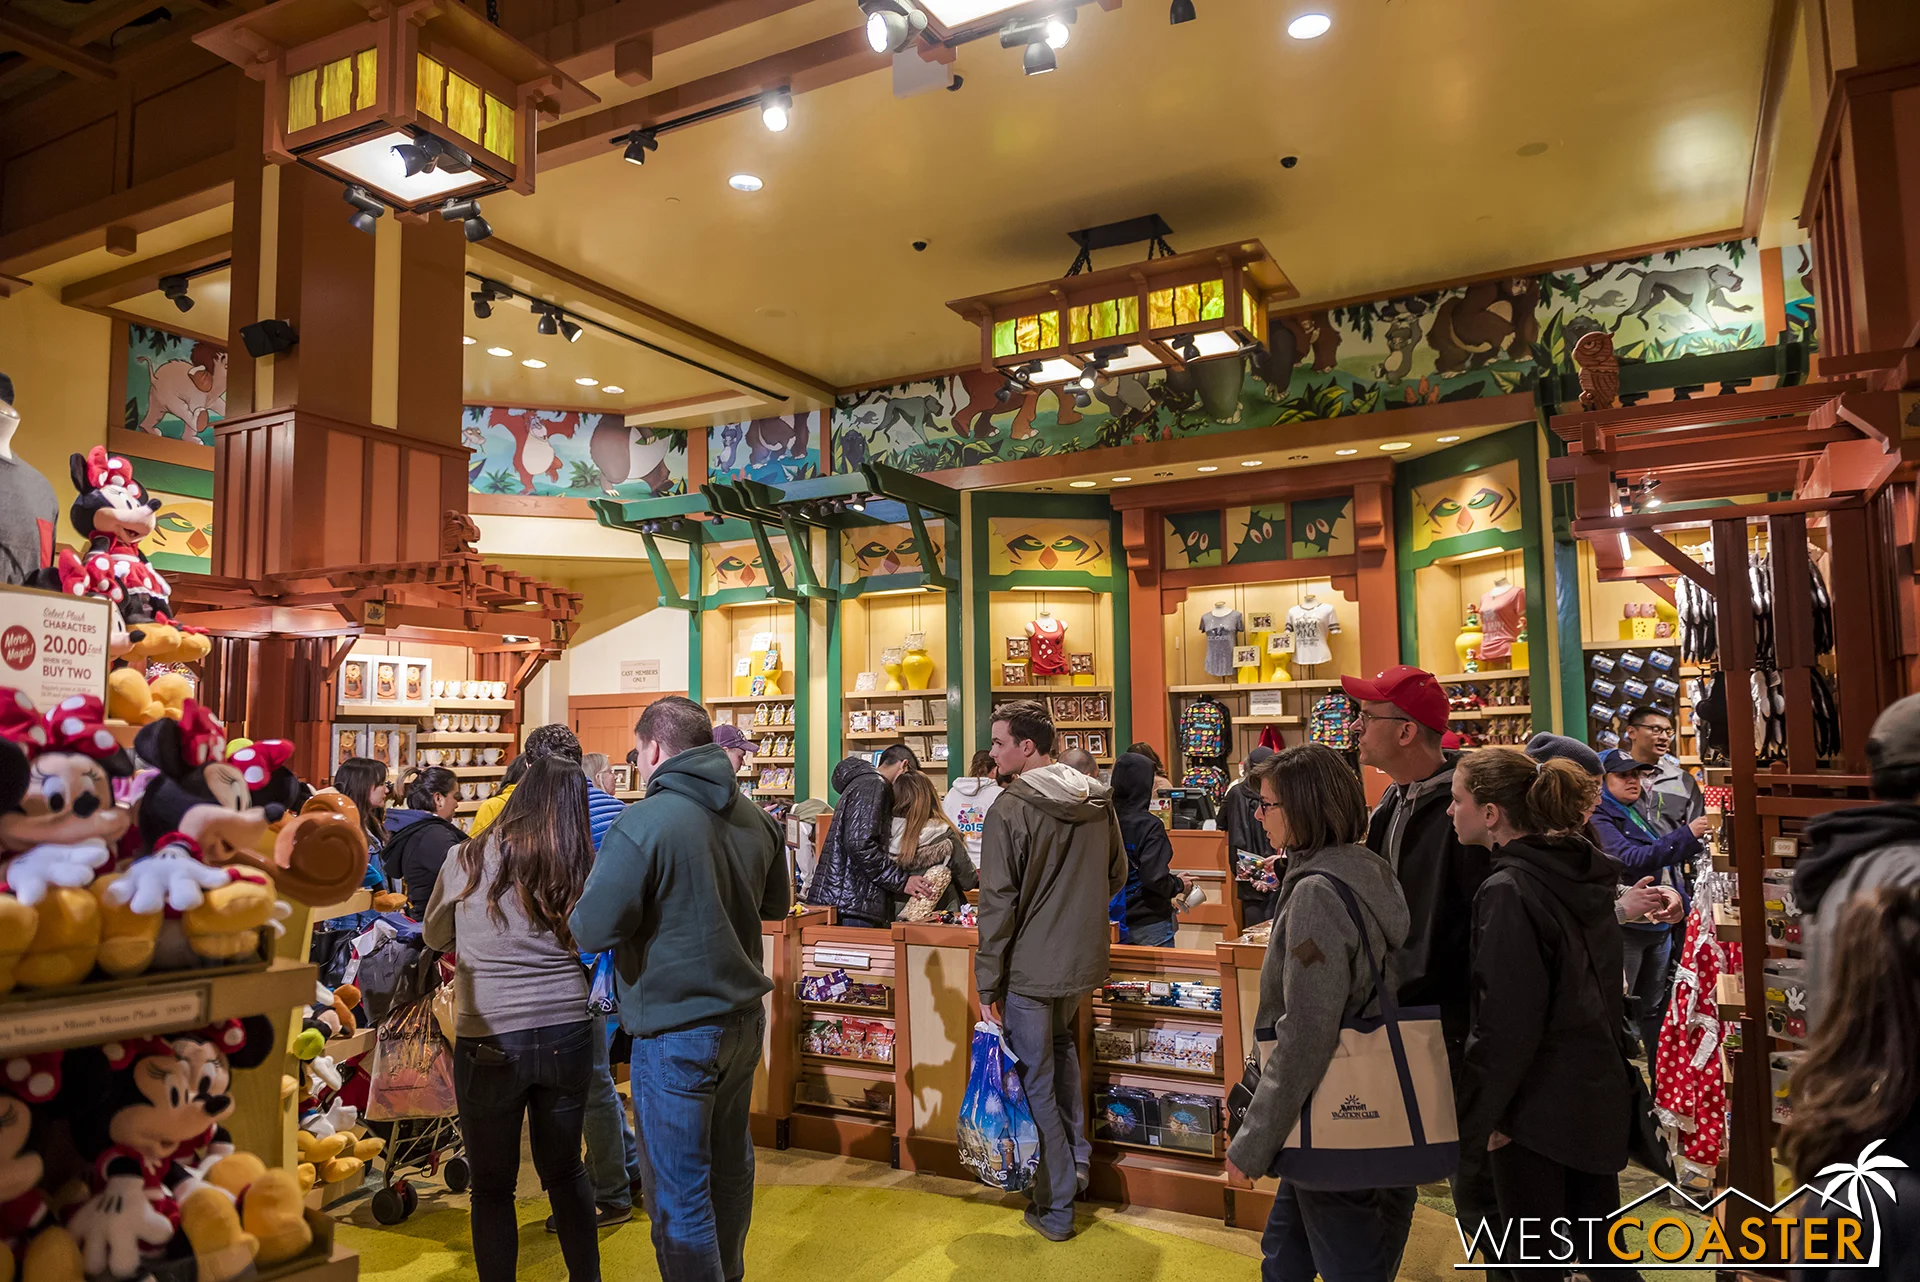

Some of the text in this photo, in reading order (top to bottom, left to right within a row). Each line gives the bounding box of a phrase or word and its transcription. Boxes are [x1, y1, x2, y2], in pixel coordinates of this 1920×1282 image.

[43, 607, 85, 621] Select Plush
[43, 619, 97, 634] CHARACTERS
[4, 633, 28, 649] More
[43, 634, 87, 656] 20.00
[6, 643, 34, 664] Magic!
[42, 657, 73, 666] WHEN YOU
[42, 665, 92, 680] BUY TWO
[957, 822, 984, 833] 2015
[1331, 1110, 1380, 1119] VACATION CLUB
